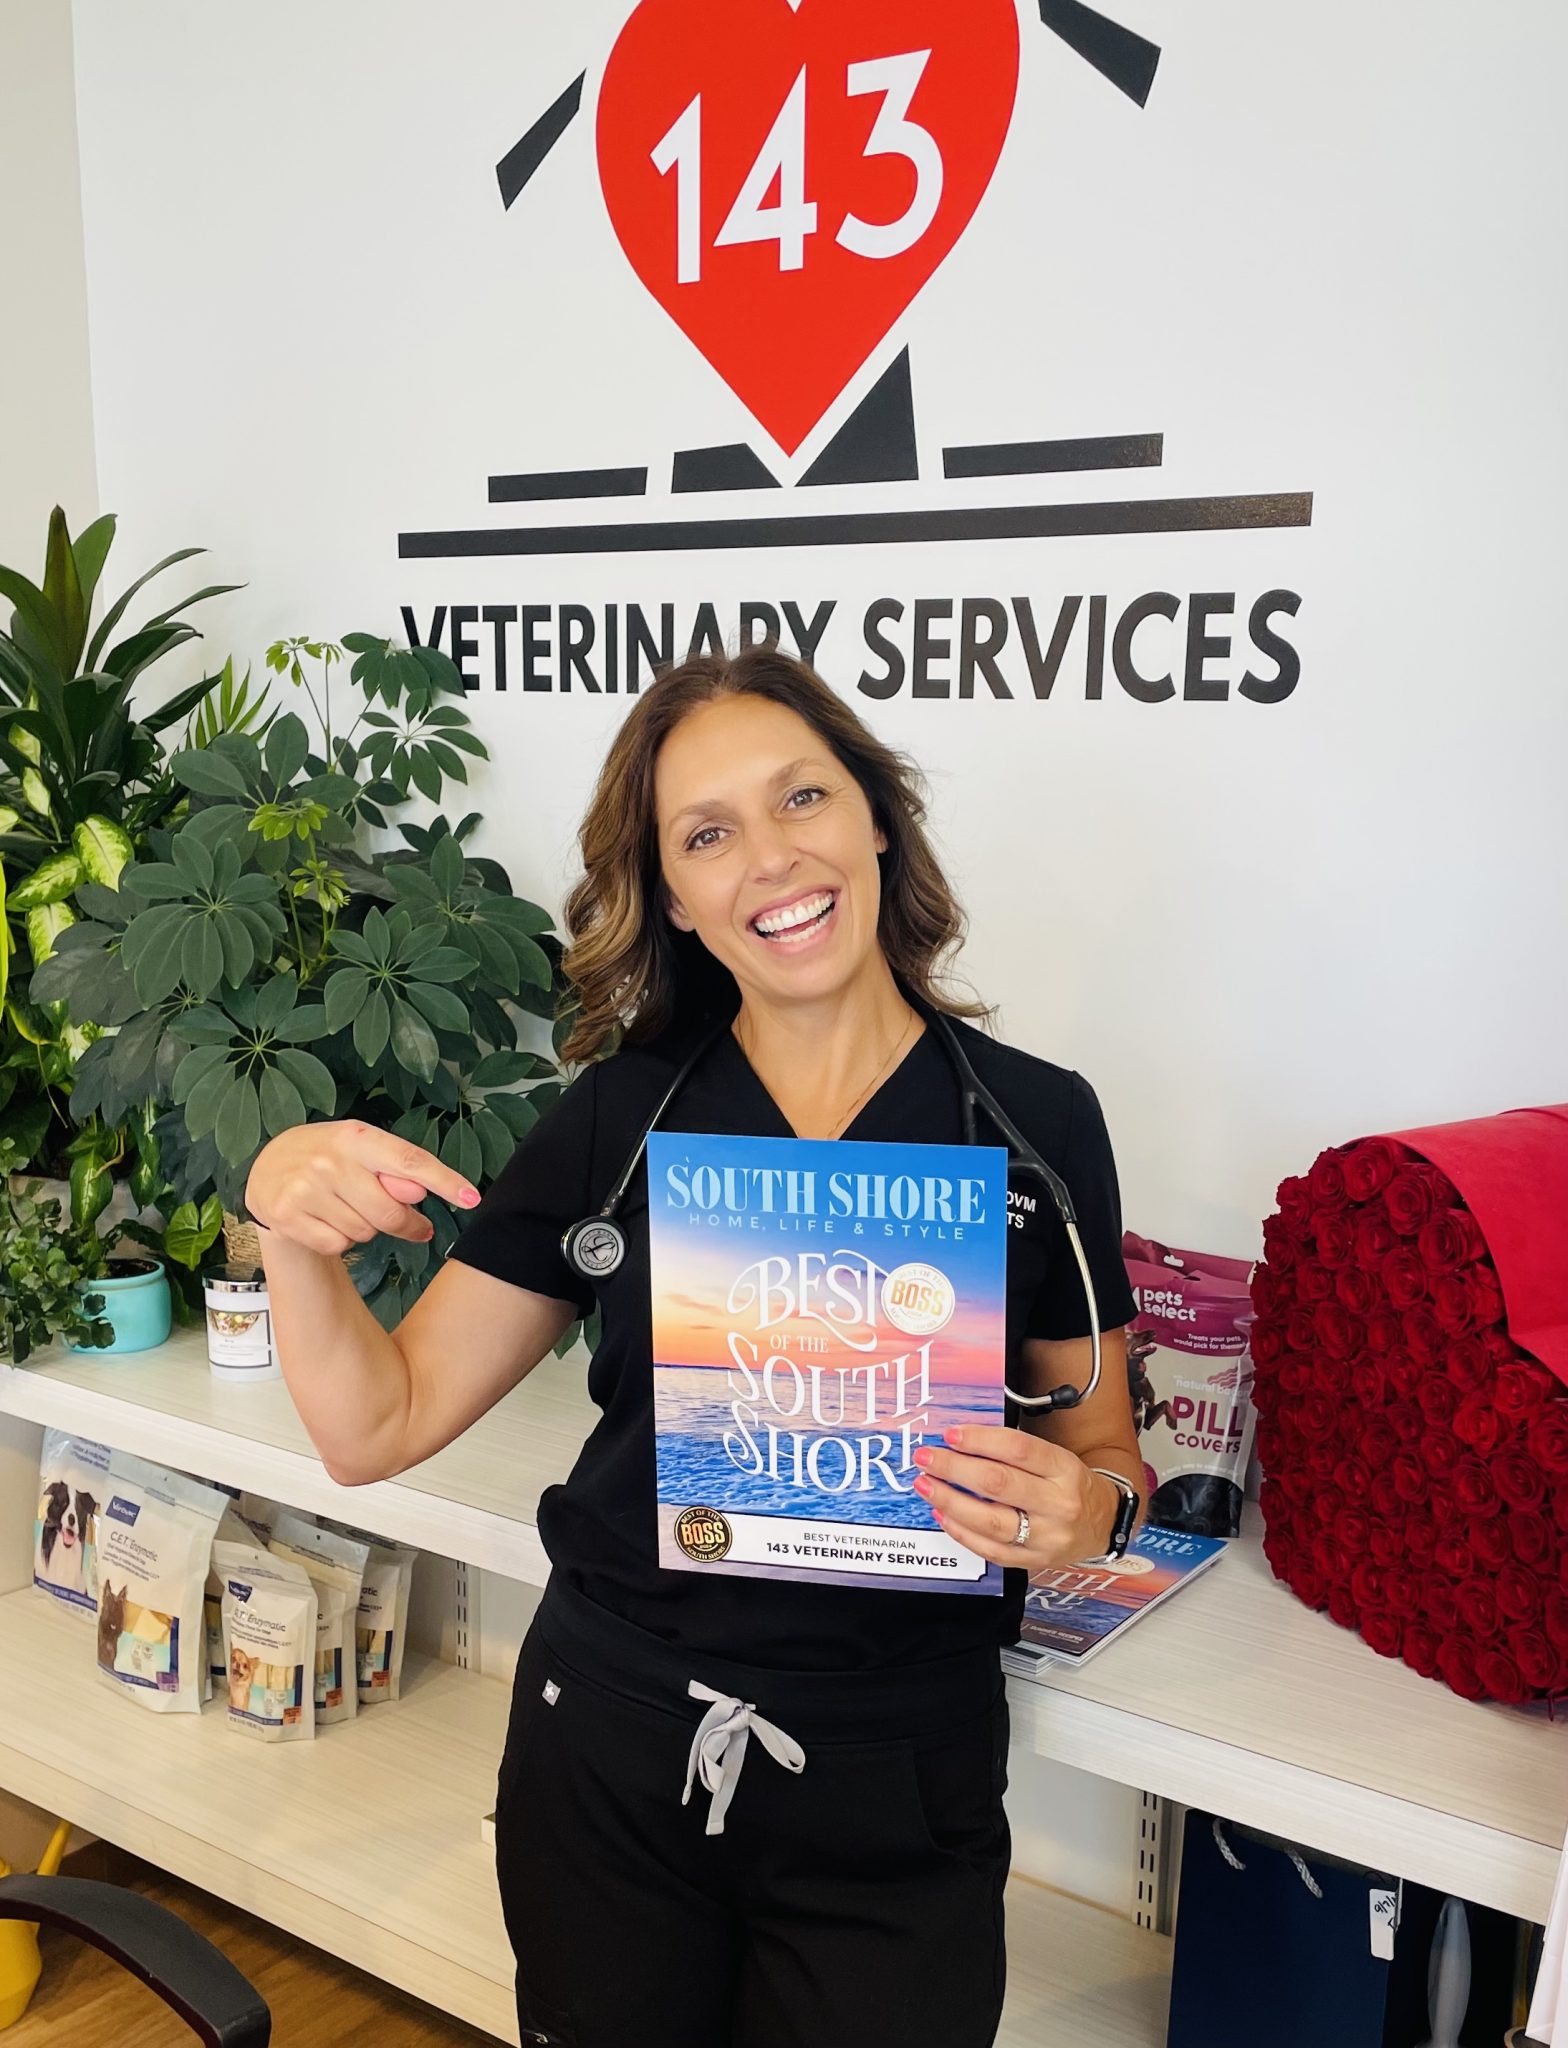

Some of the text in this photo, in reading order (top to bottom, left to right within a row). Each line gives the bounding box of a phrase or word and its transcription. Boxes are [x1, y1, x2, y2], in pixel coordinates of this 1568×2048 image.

[649, 48, 944, 285] 143
[856, 589, 1304, 703] SERVICES
[666, 1162, 986, 1225] SOUTH SHORE
[779, 1218, 835, 1234] LIFE
[854, 1223, 865, 1236] &
[884, 1224, 965, 1240] STYLE
[726, 1249, 890, 1352] BEST
[890, 1280, 944, 1316] BOSS
[1143, 1289, 1183, 1306] pets
[1143, 1303, 1197, 1322] select
[769, 1334, 830, 1353] OF THE
[727, 1331, 935, 1426] SOUTH
[1217, 1386, 1250, 1398] baon
[1173, 1395, 1243, 1437] PILL
[722, 1399, 929, 1493] SHORE
[1174, 1433, 1241, 1454] covers
[681, 1521, 726, 1546] BOSS
[803, 1532, 916, 1550] BEST VETERINARIAN
[1135, 1533, 1202, 1556] ORE
[766, 1542, 959, 1568] 143 VETERINARY SERVICES
